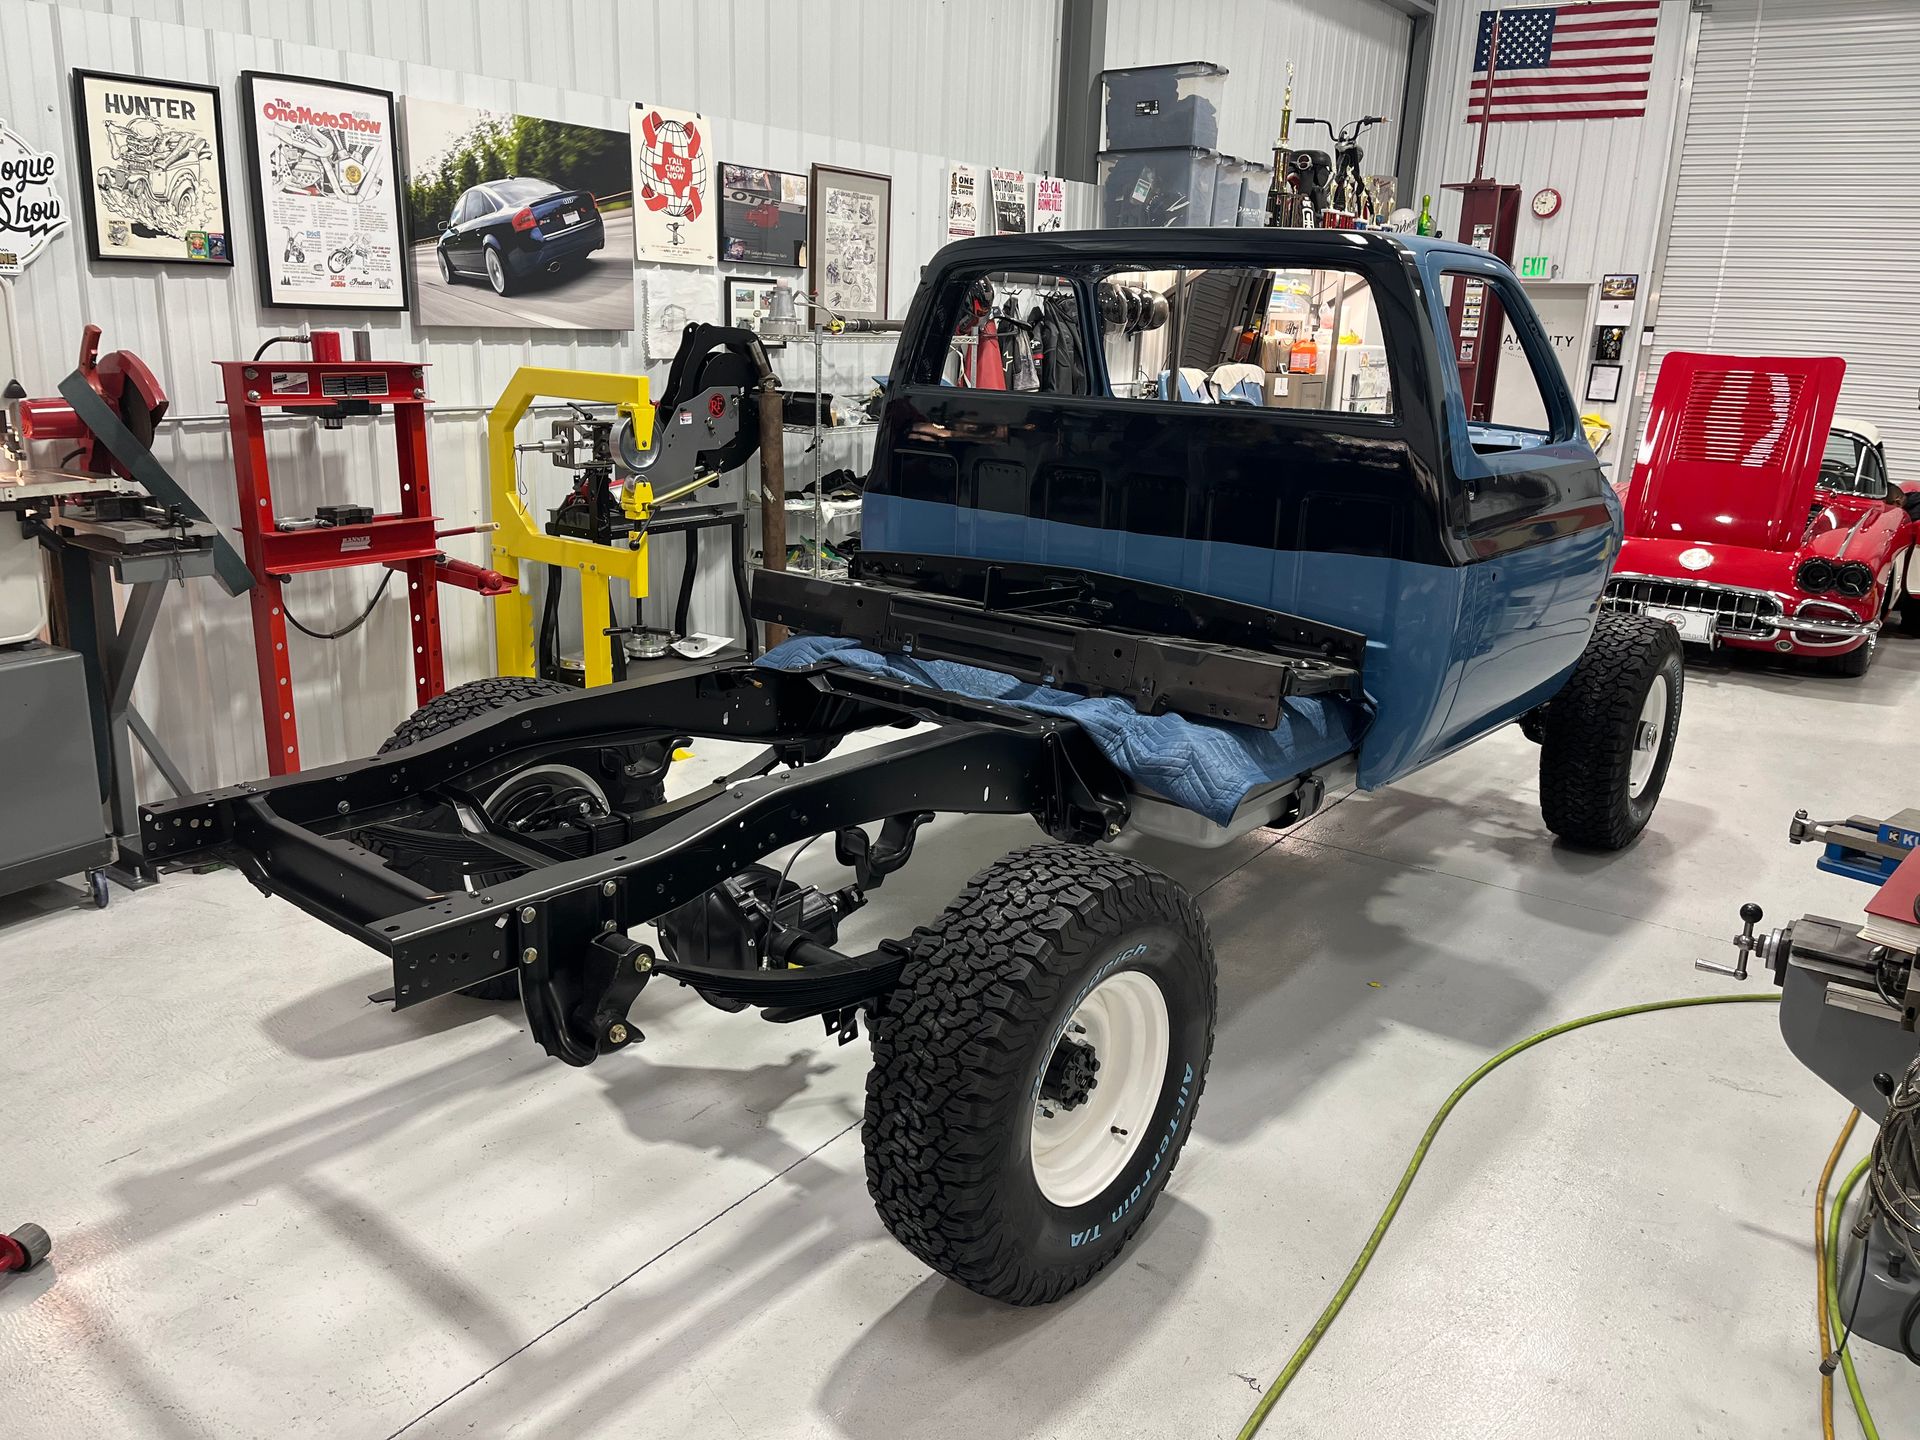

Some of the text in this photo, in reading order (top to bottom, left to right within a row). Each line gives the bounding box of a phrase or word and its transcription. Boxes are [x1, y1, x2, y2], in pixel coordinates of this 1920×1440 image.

[104, 93, 196, 120] HUNTER
[275, 98, 291, 109] The
[0, 156, 55, 193] ogue
[667, 172, 684, 181] NOW
[958, 176, 974, 186] ONE
[0, 187, 62, 230] Show
[0, 253, 18, 265] NE
[1521, 257, 1549, 276] EXIT
[711, 396, 723, 414] RF
[1070, 1062, 1193, 1248] All-Terrain T/A
